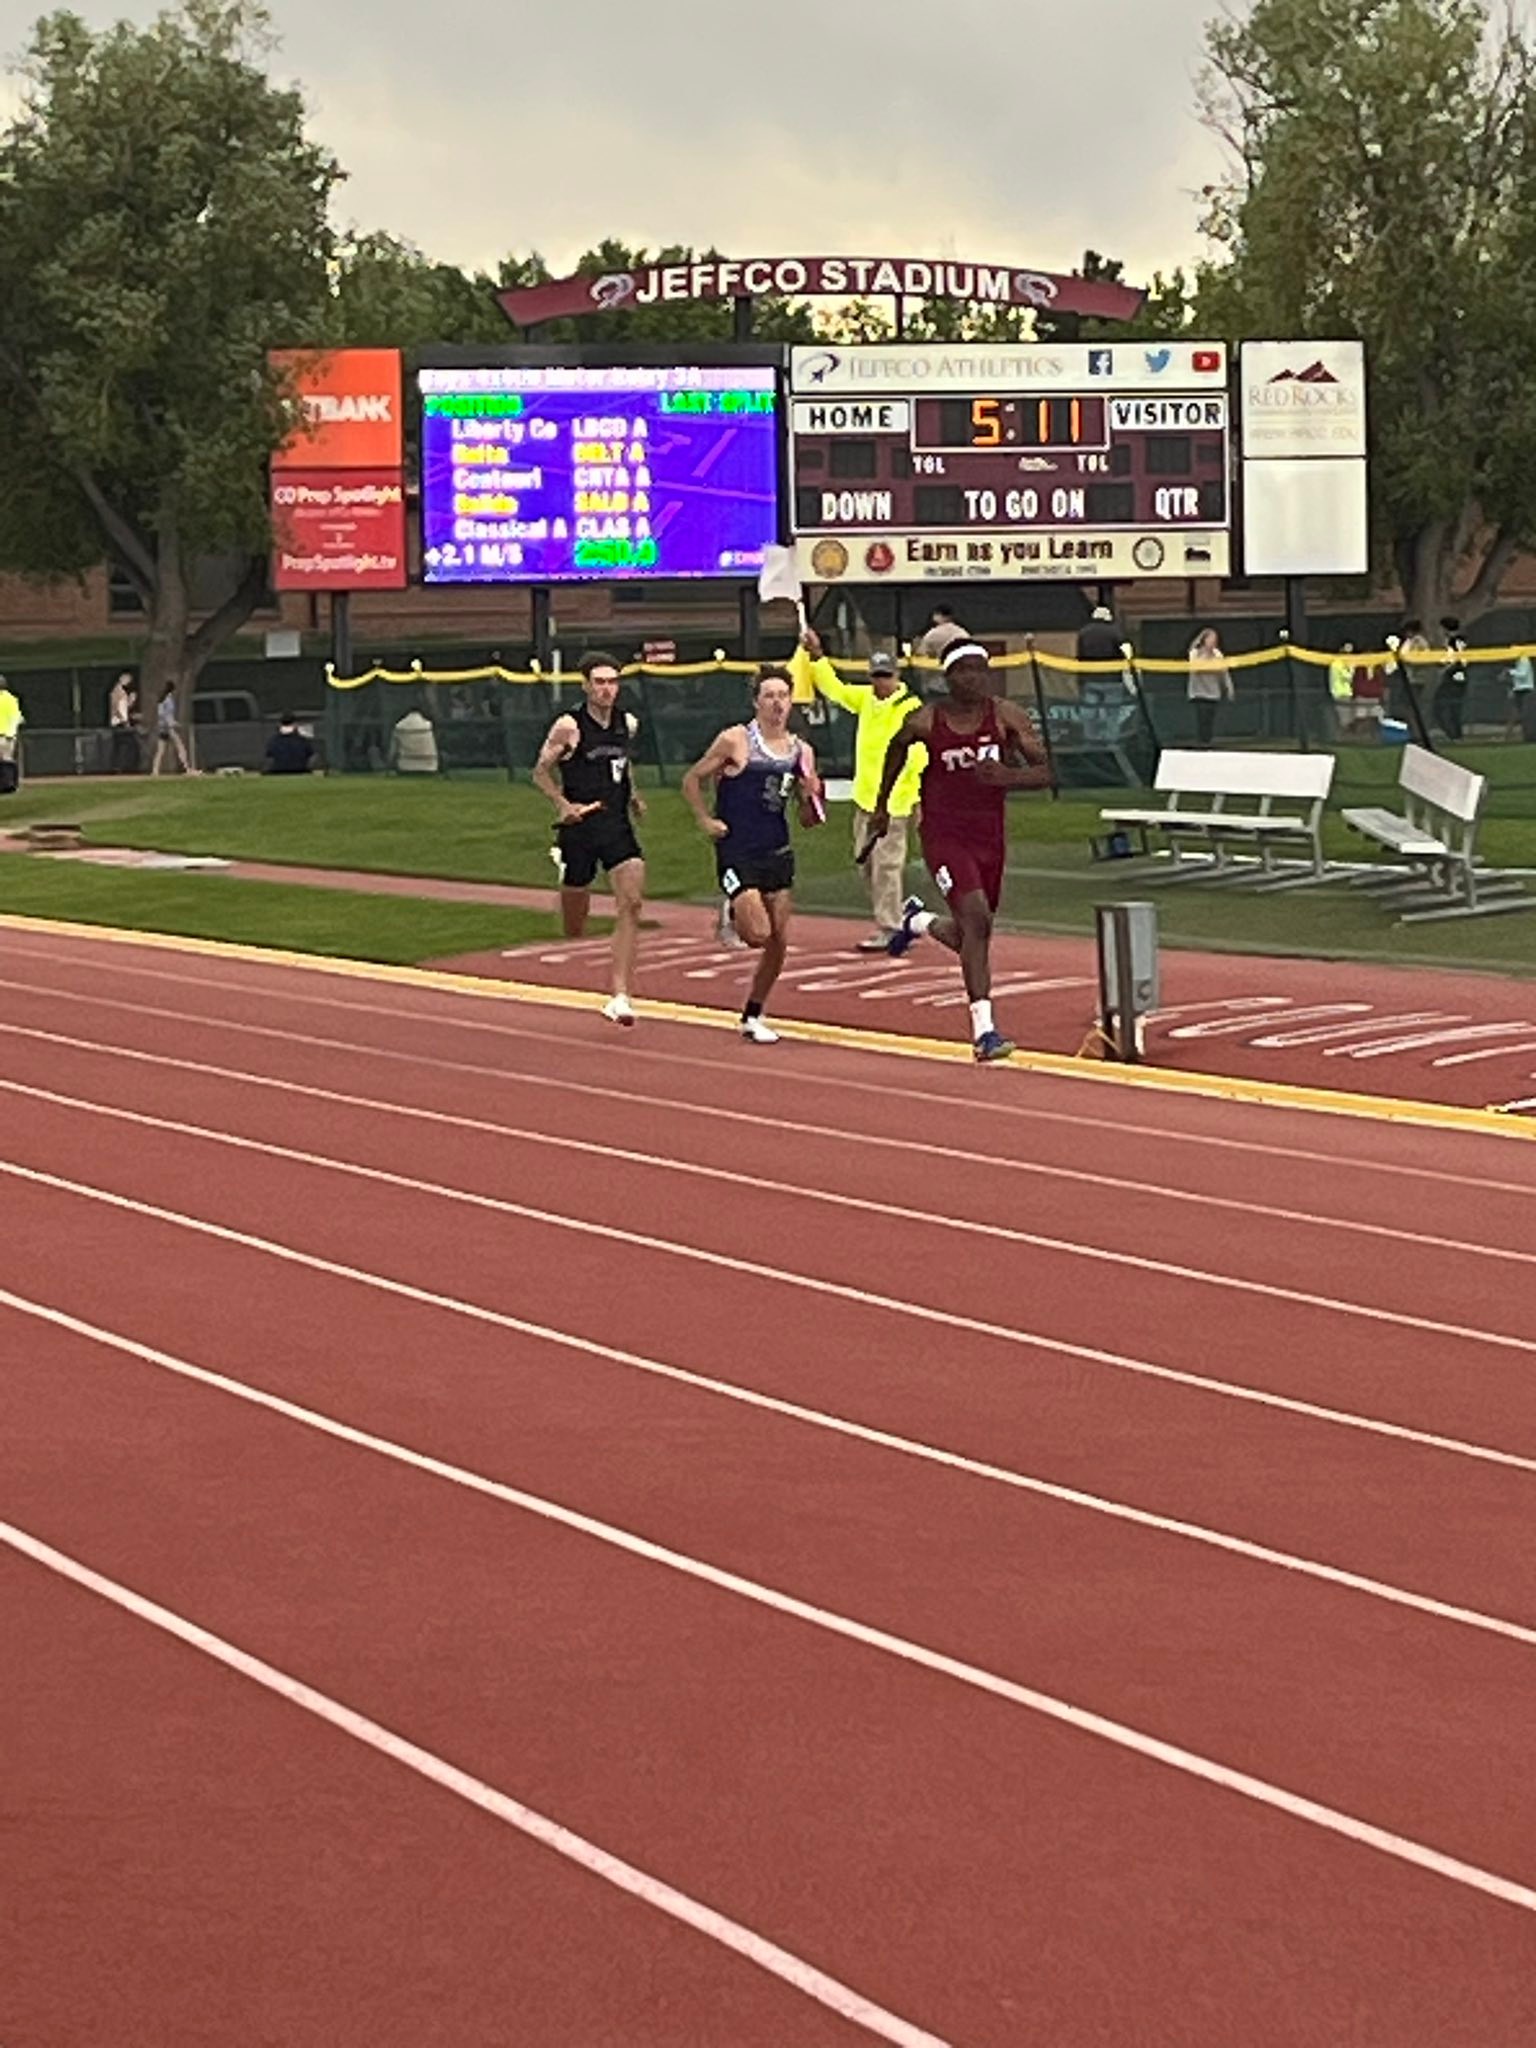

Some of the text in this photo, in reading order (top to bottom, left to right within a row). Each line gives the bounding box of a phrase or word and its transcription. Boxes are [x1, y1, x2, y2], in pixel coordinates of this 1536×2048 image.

[635, 260, 1010, 303] JEFFCO STADIUM
[850, 356, 1064, 380] JEFFCO ATHLETICS
[302, 395, 393, 422] TBANK
[809, 405, 893, 428] HOME
[970, 398, 1080, 446] 5:11
[1116, 402, 1221, 425] VISITOR
[821, 491, 892, 521] DOWN
[964, 490, 1086, 520] TO GO ON
[1154, 487, 1199, 519] QTR
[906, 536, 1114, 565] Earn as you Learn
